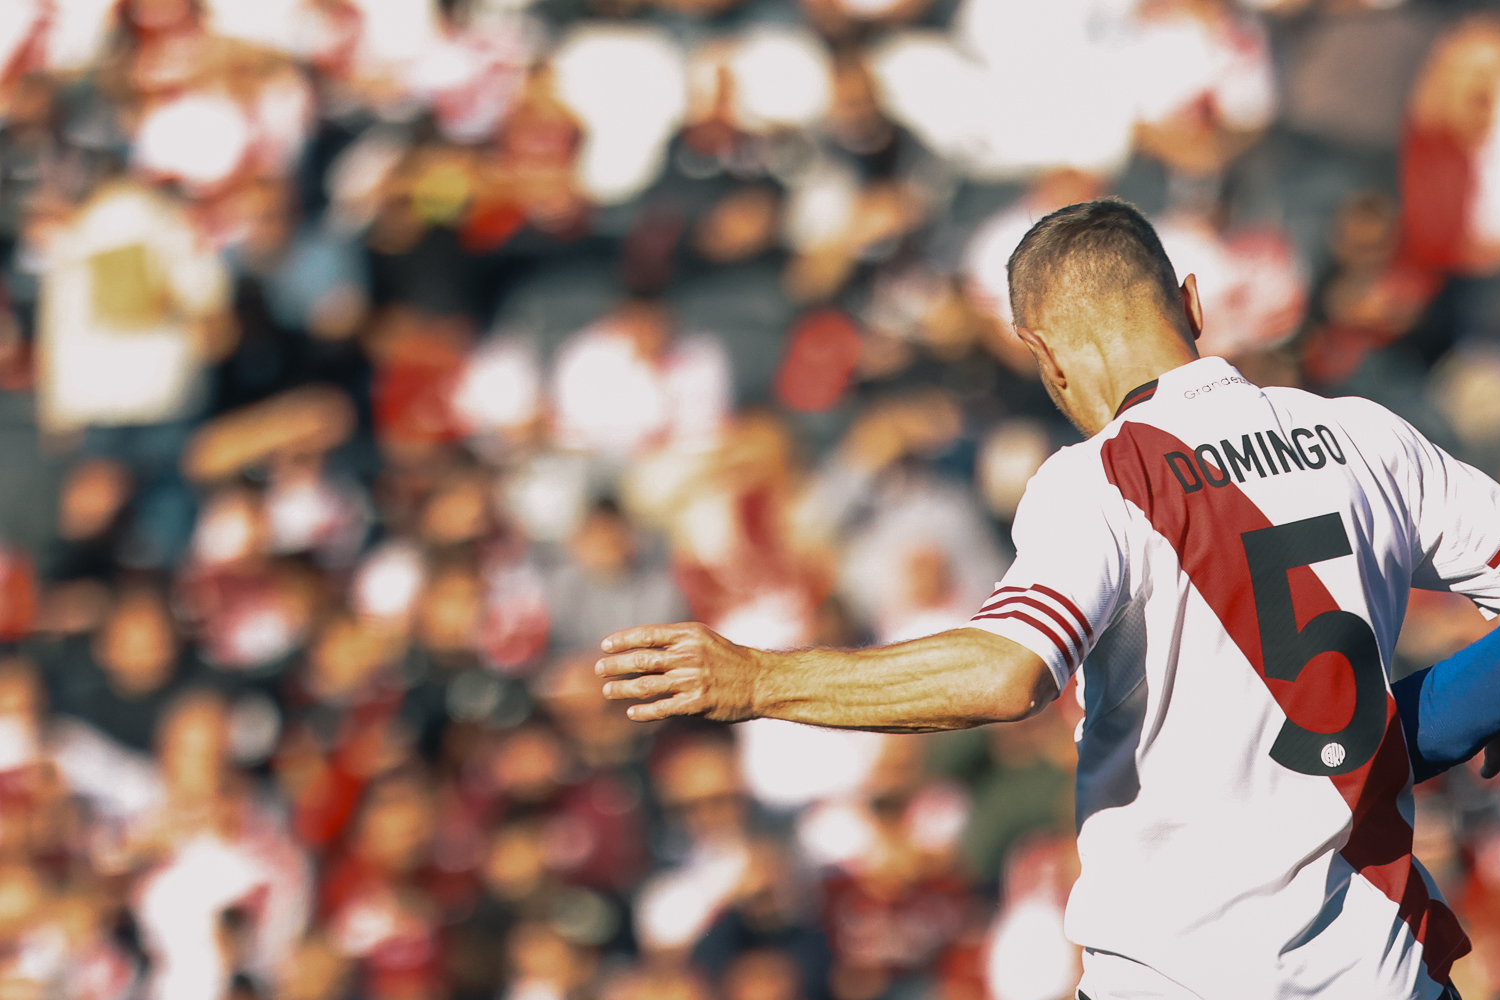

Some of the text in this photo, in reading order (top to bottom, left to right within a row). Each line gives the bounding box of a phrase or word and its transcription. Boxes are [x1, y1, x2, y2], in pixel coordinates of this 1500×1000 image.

[1184, 376, 1251, 399] Grandez
[1164, 424, 1347, 494] DOMINGO
[1240, 511, 1388, 776] 5
